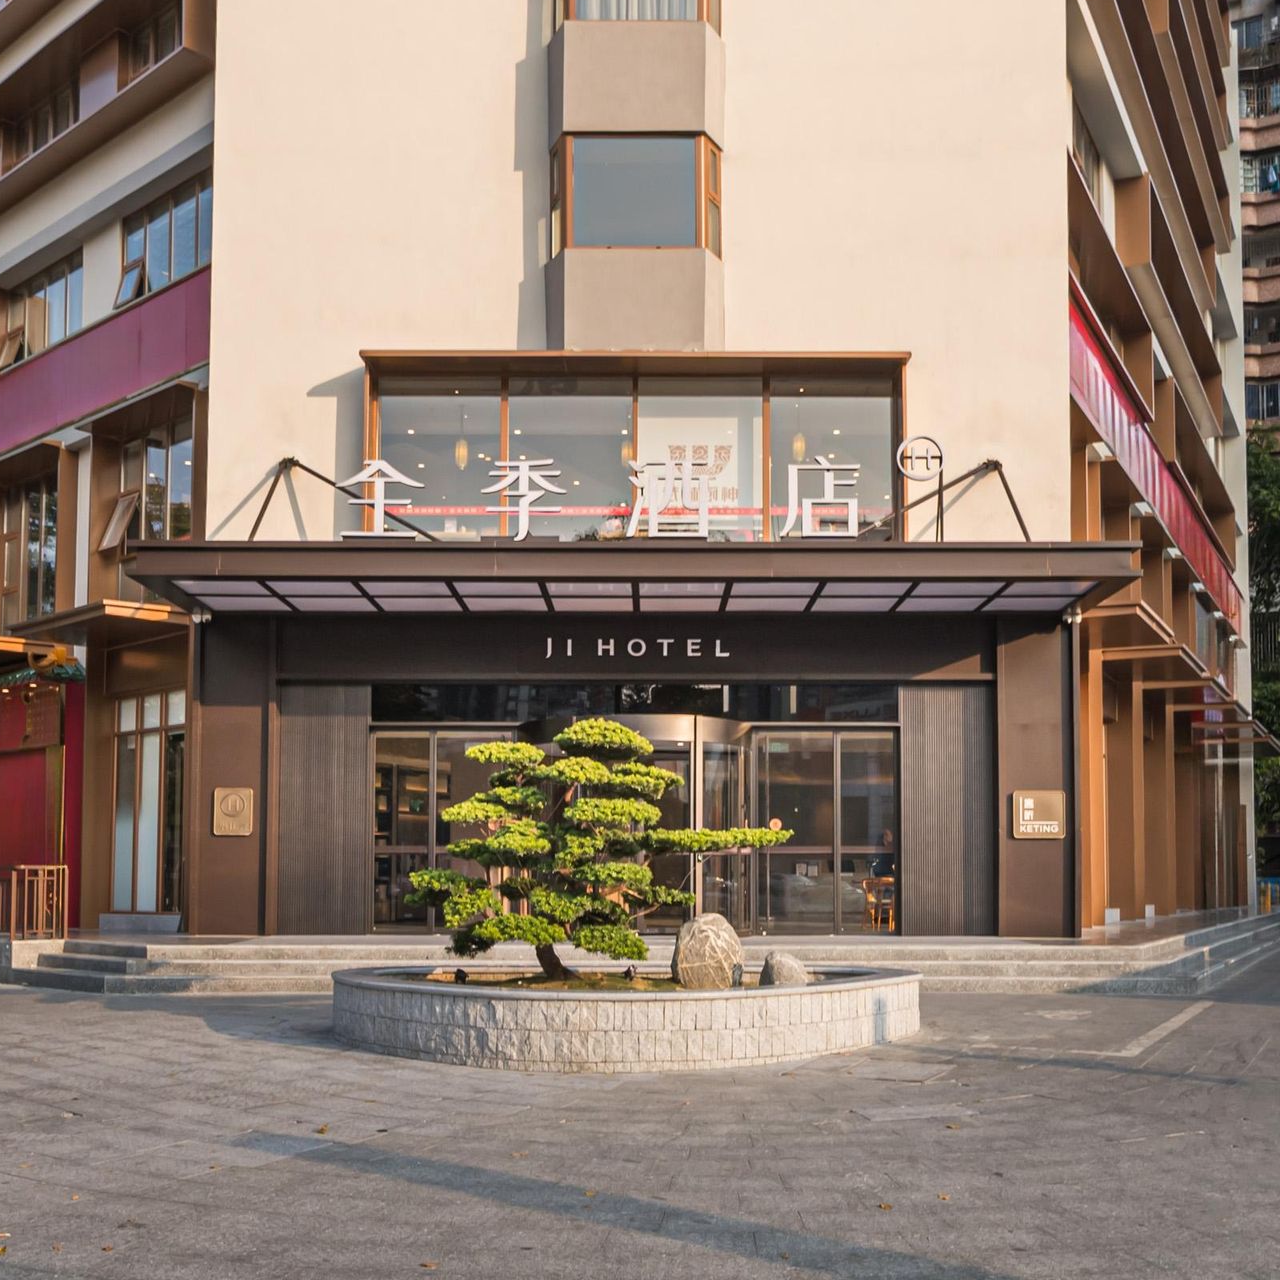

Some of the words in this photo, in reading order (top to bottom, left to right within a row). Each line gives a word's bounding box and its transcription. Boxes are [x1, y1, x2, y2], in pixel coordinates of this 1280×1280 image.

[336, 456, 861, 541] 全季酒店
[545, 637, 573, 659] JI
[597, 638, 731, 658] HOTEL
[1020, 824, 1059, 833] KETING
